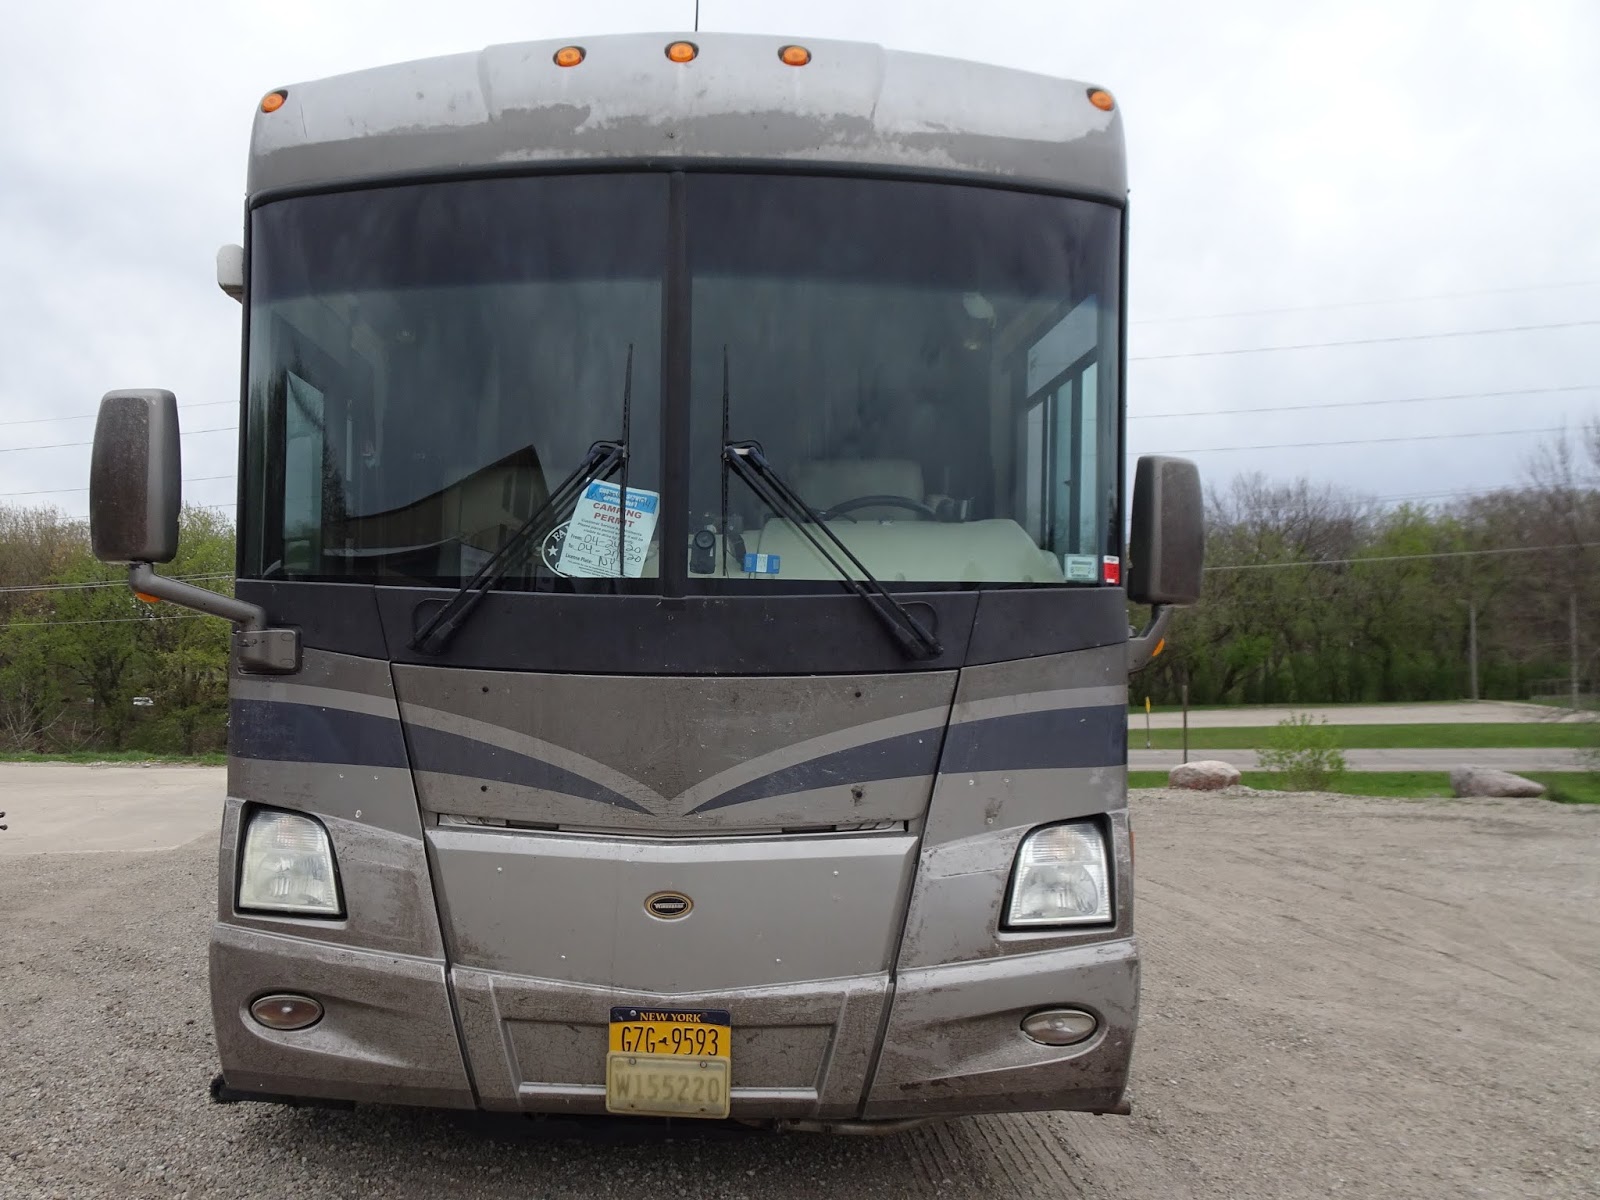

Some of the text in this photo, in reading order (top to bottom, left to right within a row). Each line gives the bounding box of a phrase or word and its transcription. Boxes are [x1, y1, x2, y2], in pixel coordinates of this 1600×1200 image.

[592, 502, 642, 519] CAMPNG
[598, 556, 616, 570] NY
[640, 1012, 702, 1022] NEW YORK
